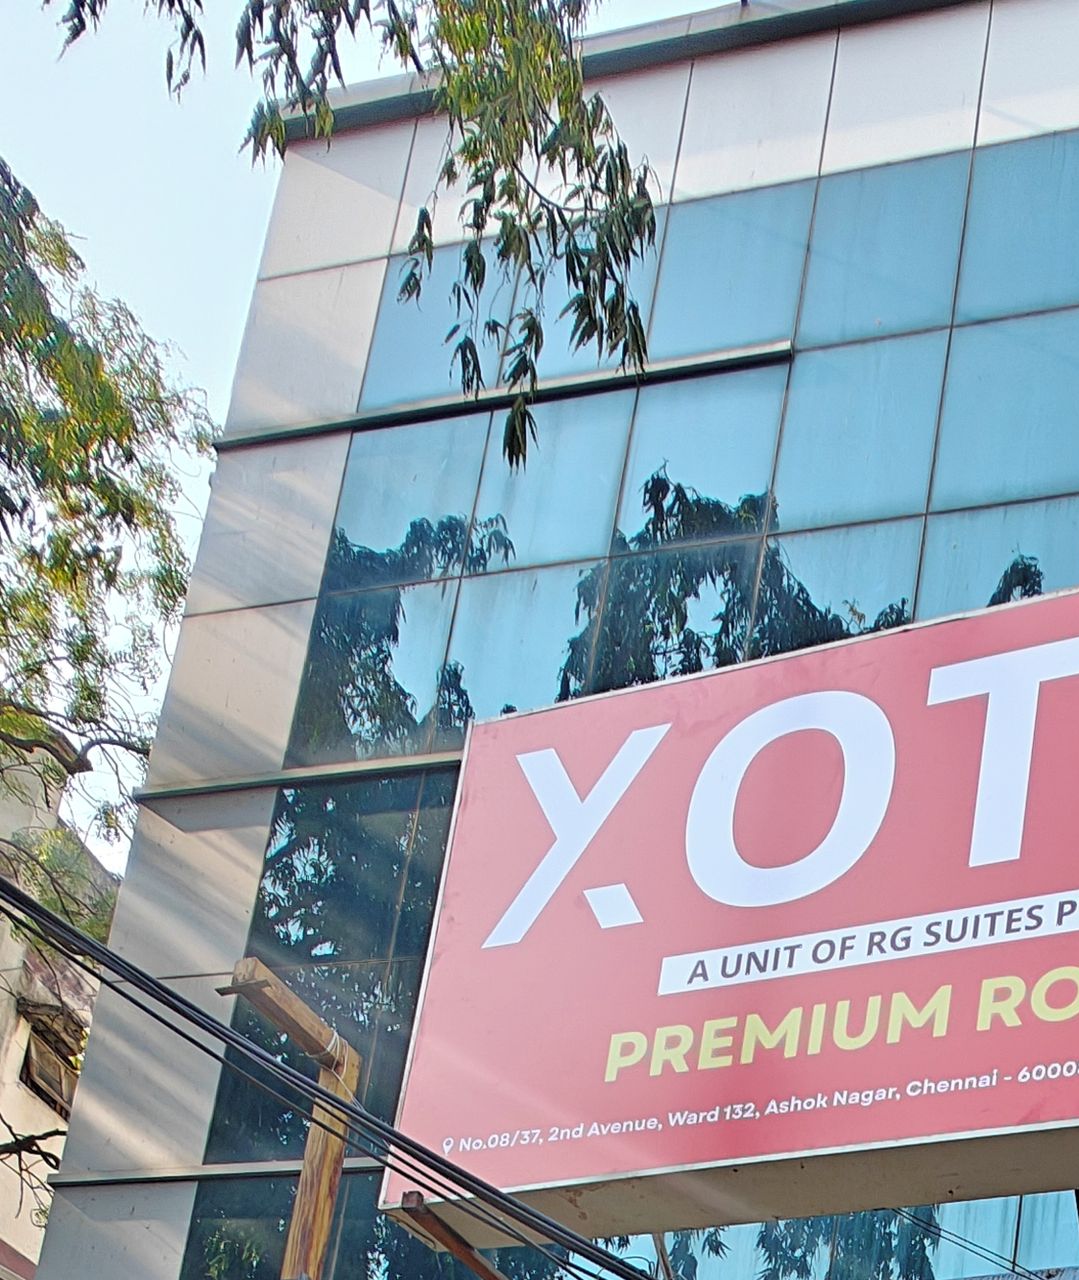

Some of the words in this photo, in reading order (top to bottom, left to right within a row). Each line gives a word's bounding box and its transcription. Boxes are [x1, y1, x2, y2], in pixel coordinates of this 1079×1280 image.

[687, 960, 709, 985] A
[720, 943, 803, 979] UNIT
[811, 935, 856, 964] OF
[866, 926, 912, 956] RG
[923, 904, 1044, 947] SUITES
[604, 984, 953, 1083] PREMIUM
[458, 1128, 543, 1152] No.08/37,
[548, 1123, 585, 1142] 2nd
[587, 1116, 663, 1138] Avenue,
[667, 1105, 720, 1128] Ward
[723, 1102, 760, 1121] 132,
[764, 1092, 829, 1116] Ashok
[832, 1084, 902, 1109] Nagar,
[905, 1068, 999, 1098] Chennai
